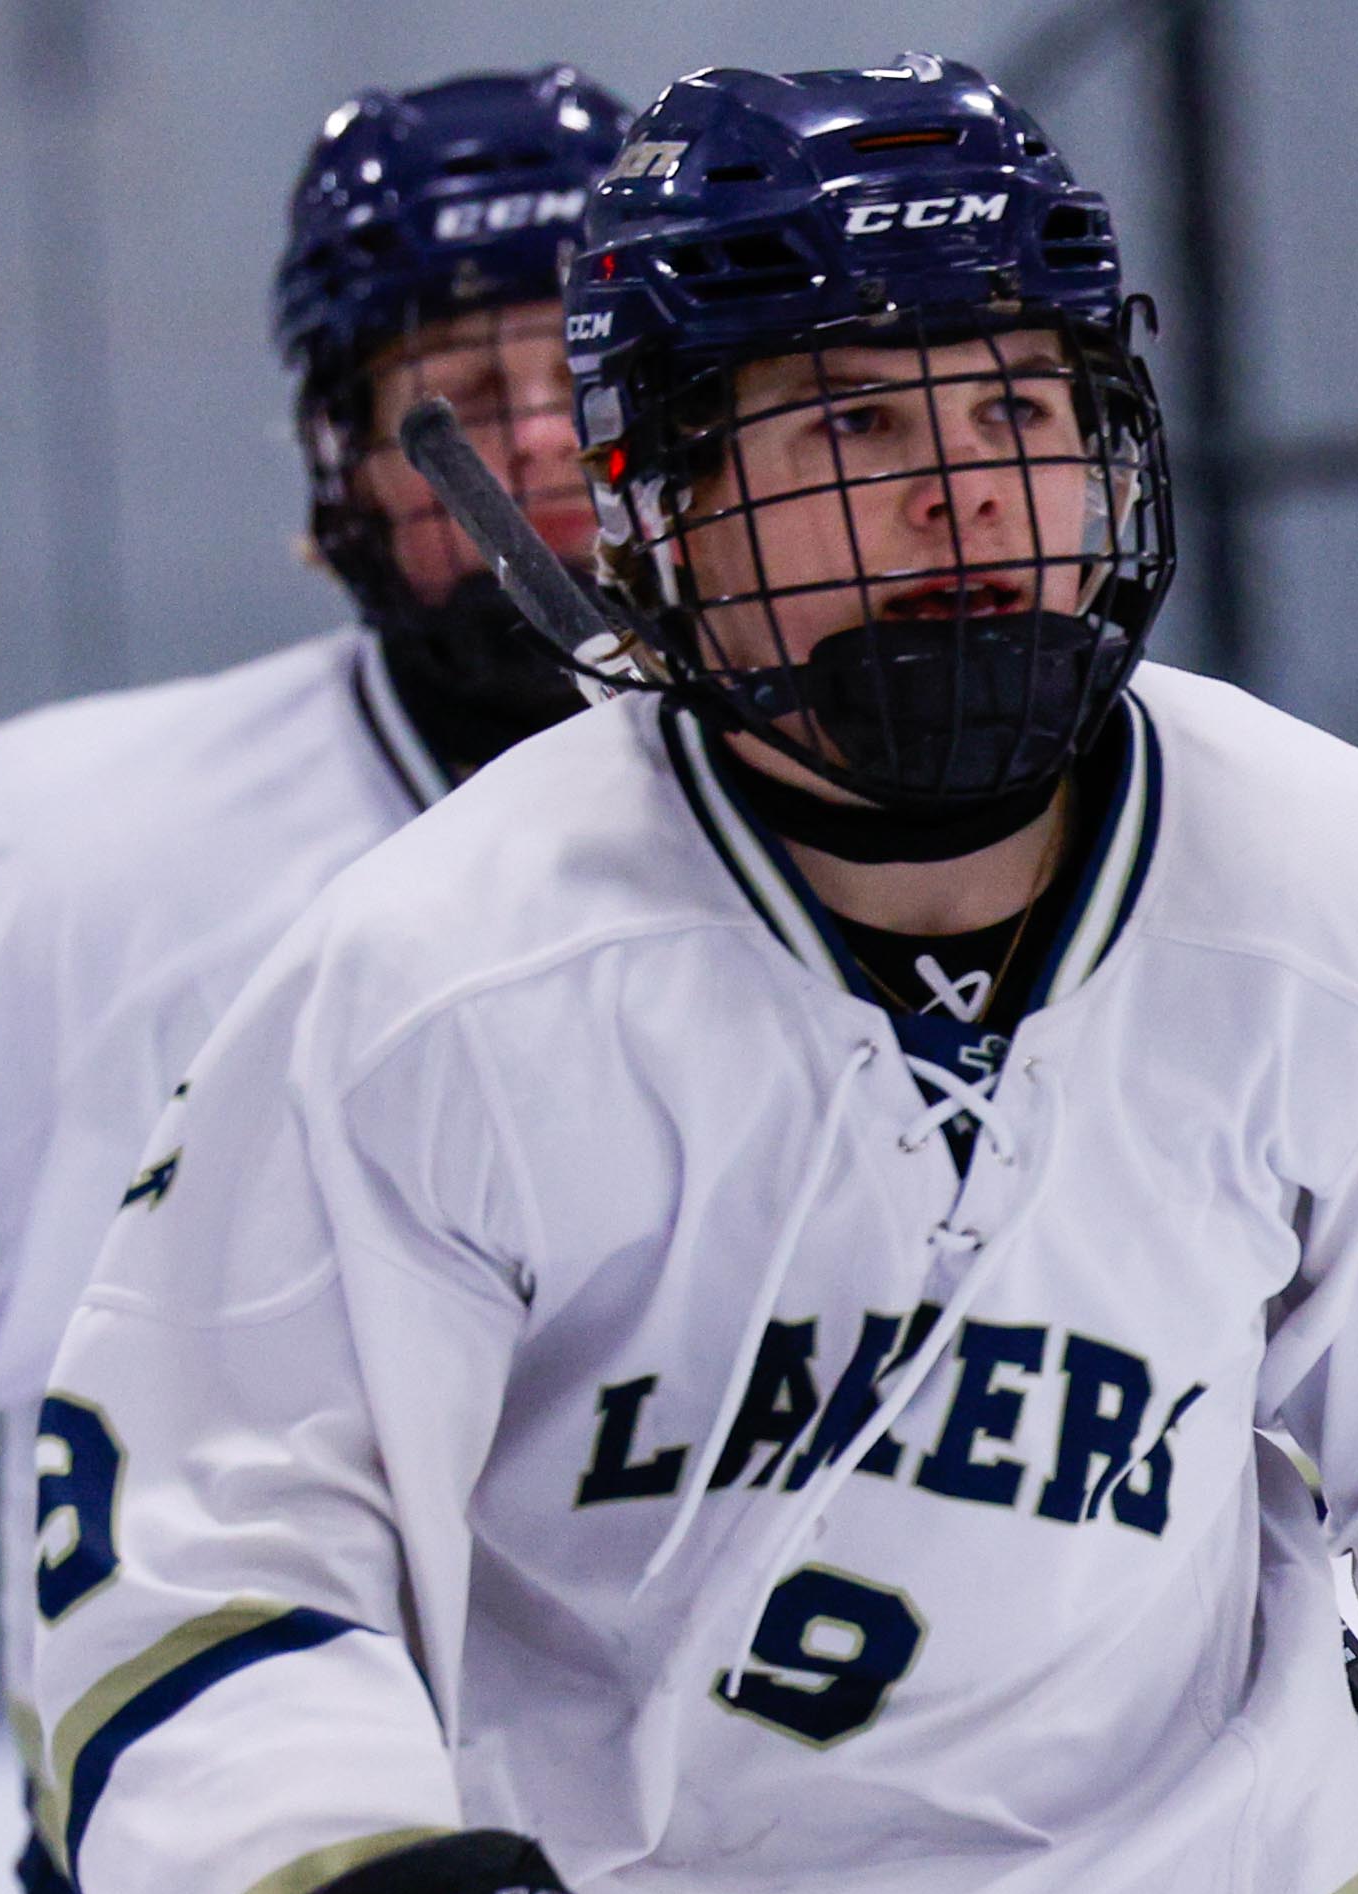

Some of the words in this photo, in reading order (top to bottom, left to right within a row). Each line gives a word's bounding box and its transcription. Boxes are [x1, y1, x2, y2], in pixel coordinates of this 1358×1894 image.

[844, 193, 1010, 235] CCM
[565, 310, 615, 342] CCM
[571, 1303, 1210, 1540] LAKERS
[708, 1561, 930, 1752] 9
